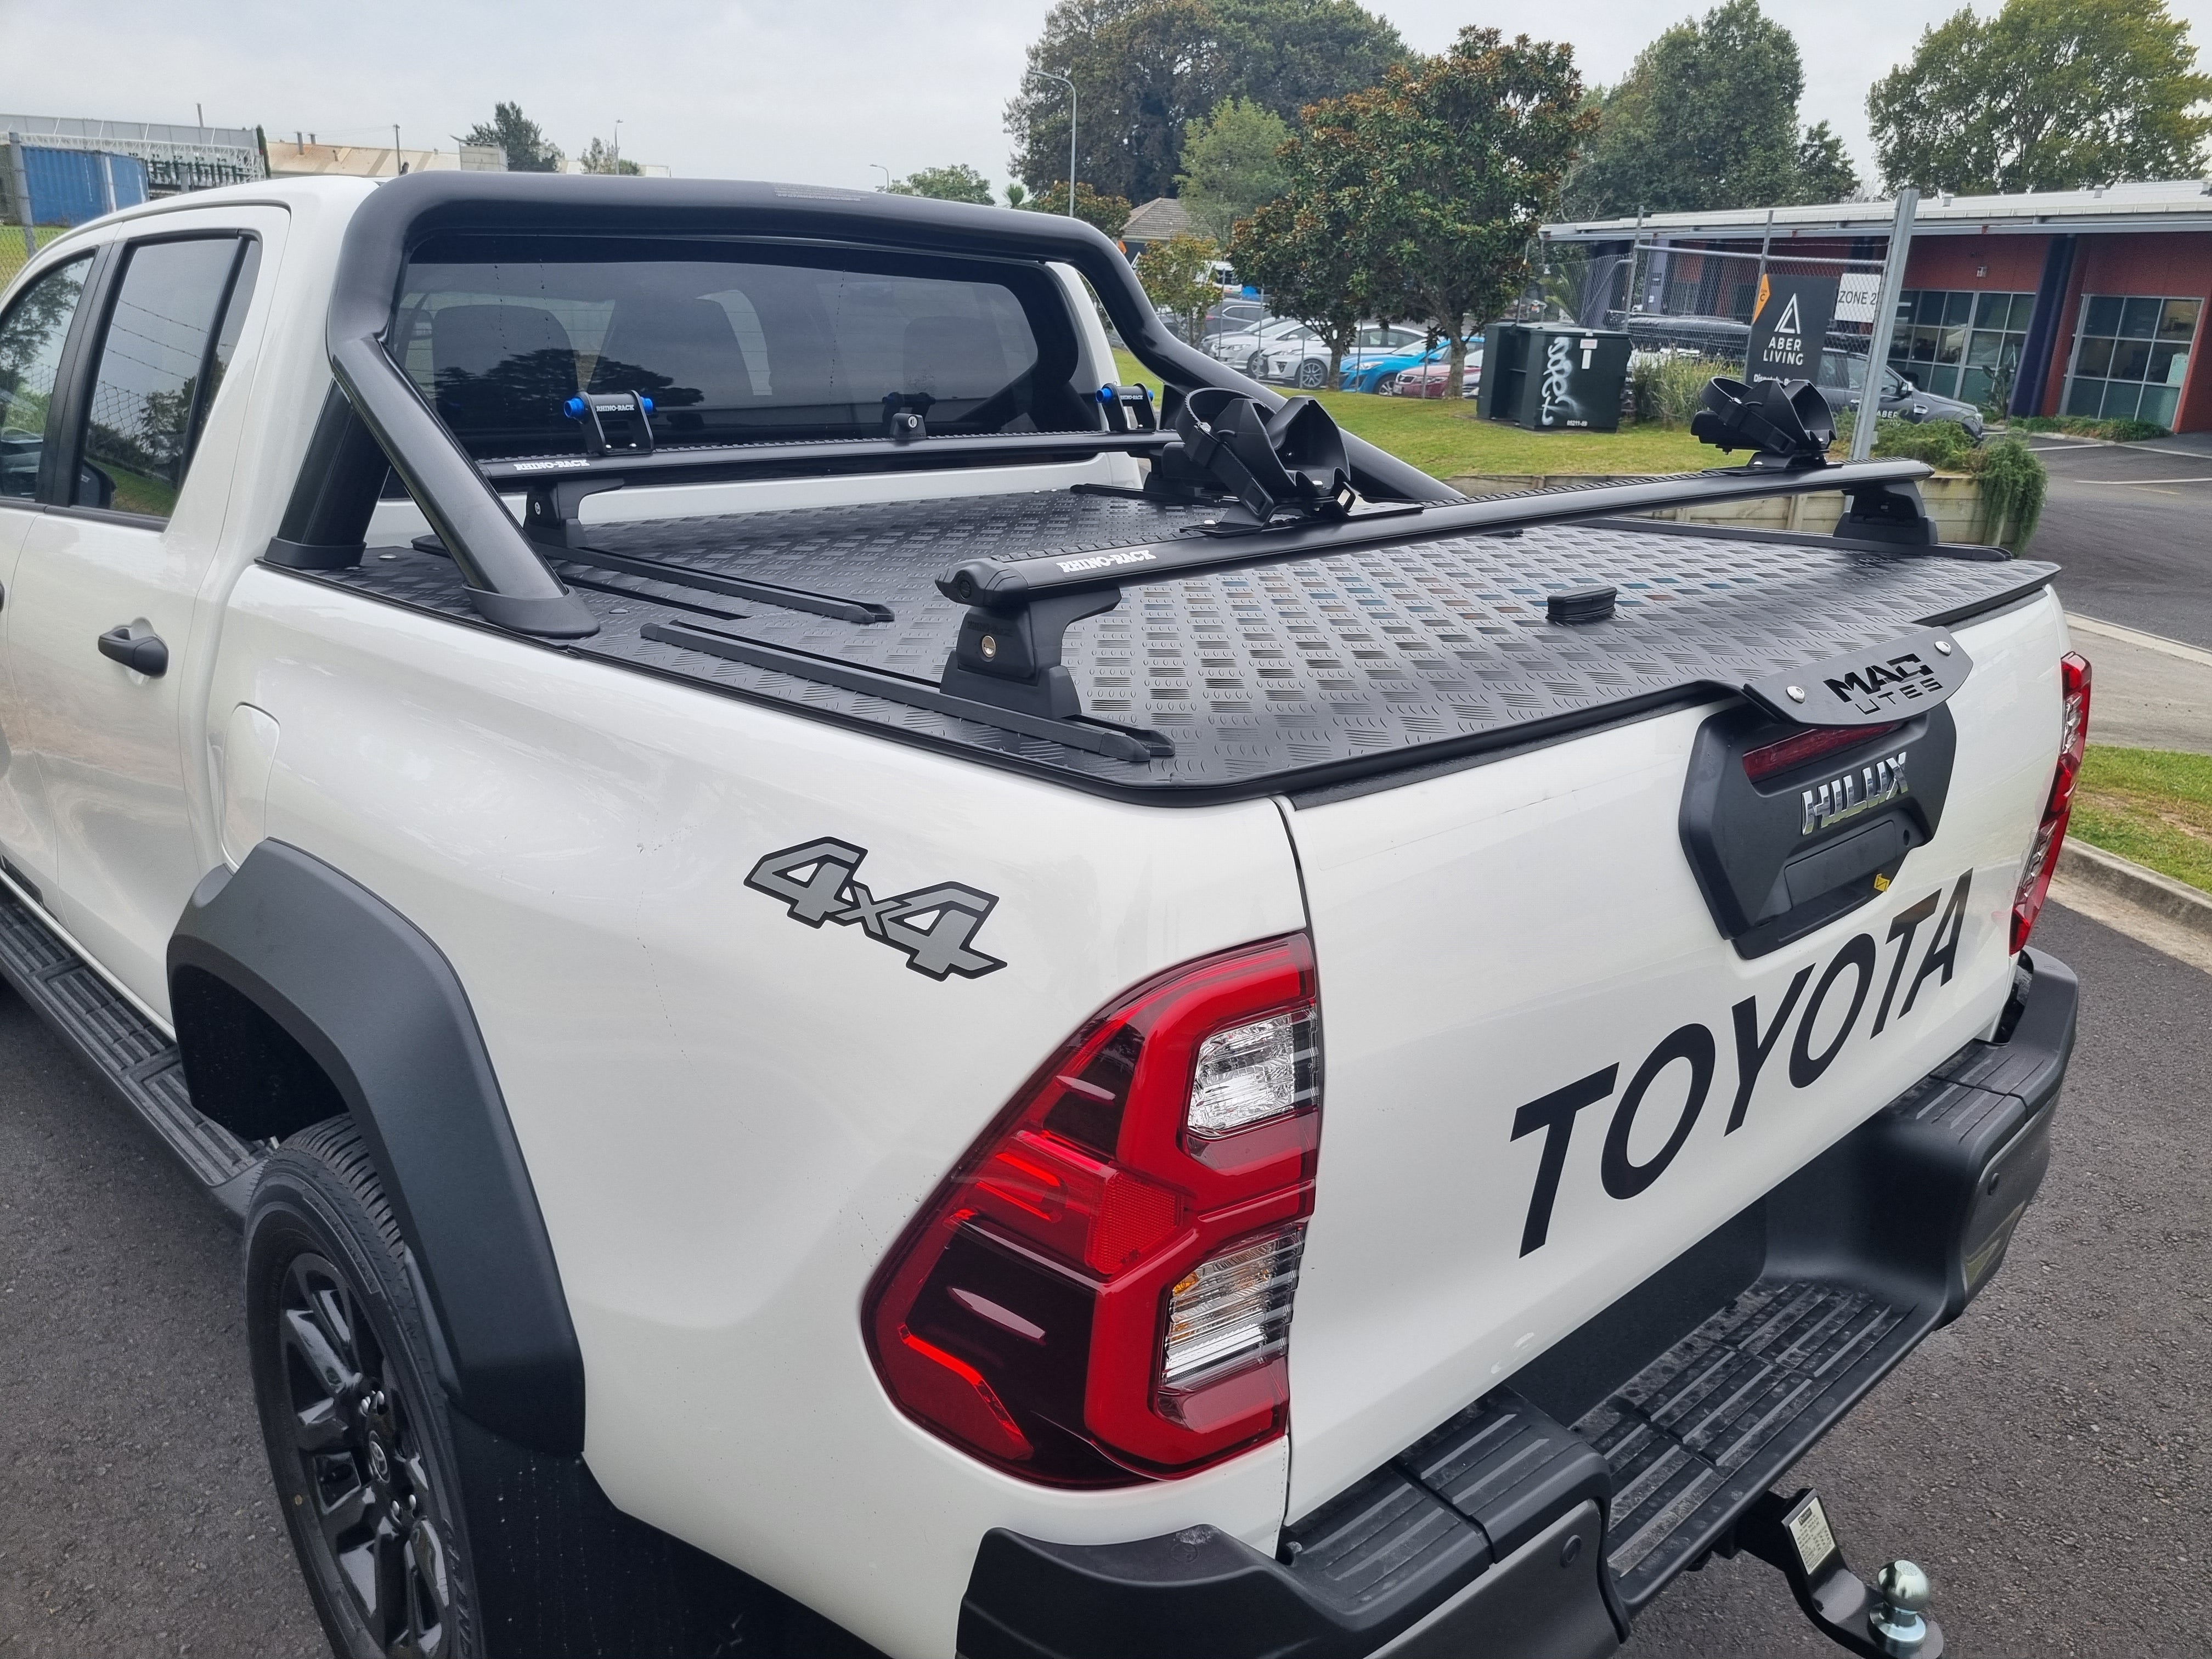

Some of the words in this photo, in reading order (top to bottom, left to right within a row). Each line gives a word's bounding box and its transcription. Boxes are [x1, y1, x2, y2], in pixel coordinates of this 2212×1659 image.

[1760, 294, 1765, 302] C
[1838, 290, 1868, 304] ZONE
[1870, 292, 1877, 305] 2
[1768, 336, 1802, 352] ABER
[1763, 349, 1804, 366] LIVING
[514, 459, 590, 471] RHINO-RACK
[1056, 550, 1157, 573] RHINO-RACK
[1855, 678, 1943, 715] UTES
[1801, 751, 1908, 836] HILUX
[1509, 867, 1973, 1259] TOYOTA
